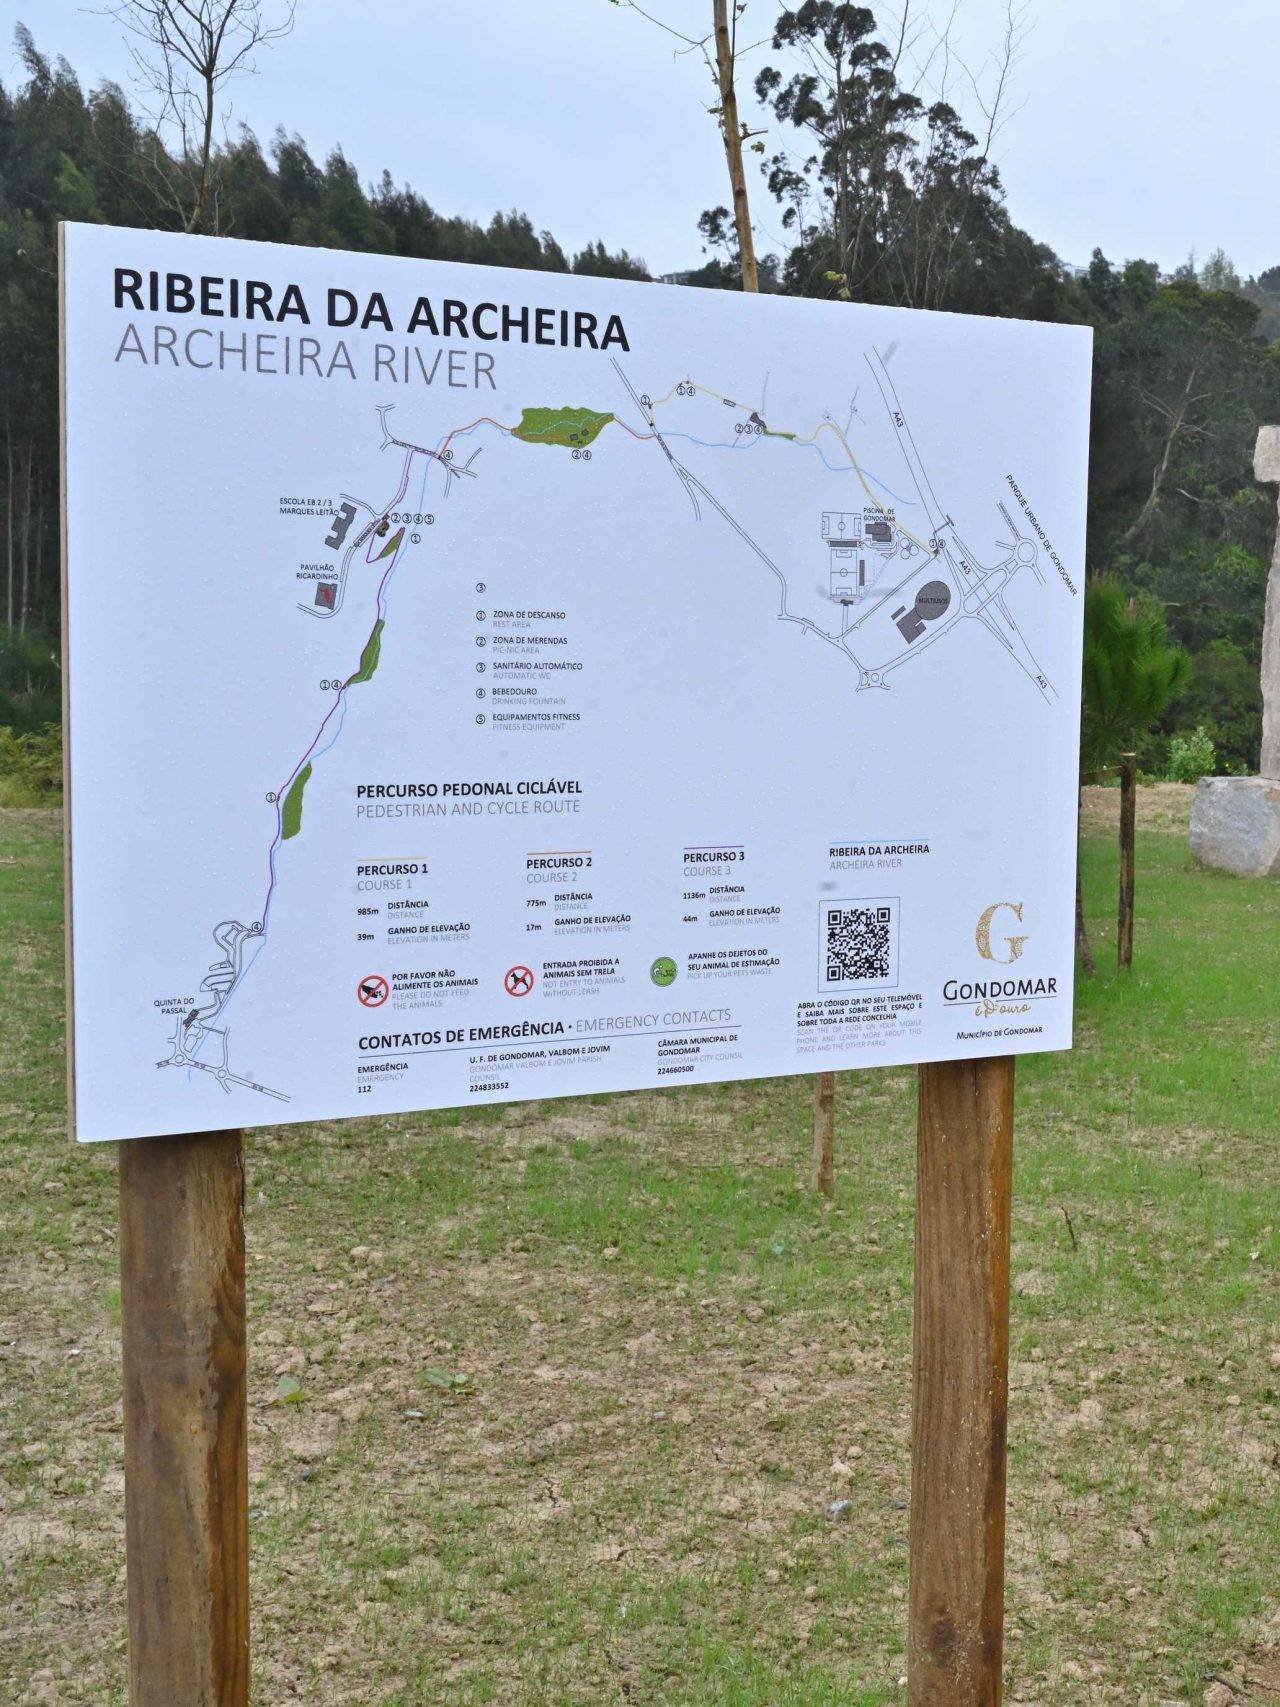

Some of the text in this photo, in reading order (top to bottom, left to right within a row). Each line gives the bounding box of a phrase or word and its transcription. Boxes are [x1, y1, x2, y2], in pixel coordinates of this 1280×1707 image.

[114, 268, 630, 352] RIBEIRA DA ARCHEIRA
[115, 323, 497, 390] ARCHEIRA RIVER
[893, 411, 904, 428] A43
[280, 498, 306, 506] ESCOLA
[307, 498, 316, 506] EB
[279, 507, 340, 516] MARQUES LEITÃO
[1006, 474, 1078, 597] PARQUE URBANO DE GONDOMAR
[300, 563, 335, 572] PAVILHÃO
[959, 560, 971, 575] A43
[296, 572, 339, 581] RICARDINHO
[493, 610, 566, 620] ZONA DE DESCANSO
[493, 636, 514, 644] ZONA
[527, 637, 568, 645] MERENDAS
[493, 661, 583, 671] SANITÁRIO AUTOMÁTICO
[1036, 675, 1048, 690] A43
[492, 688, 538, 696] BEBEDOURO
[492, 713, 551, 722] EQUIPAMENTOS
[357, 778, 583, 798] PERCURSO PEDONAL CICLÁVEL
[357, 800, 581, 818] PEDESTRIAN AND CYCLE ROUTE
[683, 851, 745, 863] PERCURSO 3
[829, 844, 930, 858] RIBEIRA DA ARCHEIRA
[357, 863, 428, 876] PERCURSO 1
[526, 857, 592, 870] PERCURSO 2
[829, 858, 902, 870] ARCHEIRA RIVER
[683, 866, 722, 877] COURSE
[526, 872, 569, 884] COURSE
[357, 879, 402, 892] COURSE
[709, 885, 745, 894] DISTÂNCIA
[554, 892, 593, 901] DISTÂNCIA
[682, 892, 706, 900] 1136m
[388, 900, 430, 910] DISTÂNCIA
[357, 908, 379, 916] 985m
[709, 909, 735, 918] GANHO
[746, 906, 781, 916] ELEVAÇÃO
[554, 918, 582, 926] GANHO
[594, 914, 631, 924] ELEVAÇÃO
[388, 926, 418, 935] GANHO
[431, 922, 471, 932] ELEVAÇÃO
[526, 924, 542, 932] 17m
[975, 901, 1030, 965] G
[357, 932, 375, 941] 39m
[688, 952, 716, 960] APANHE
[728, 949, 757, 958] DEJETOS
[758, 948, 768, 956] DO
[543, 960, 577, 970] ENTRADA
[578, 958, 613, 968] PROIBIDA
[688, 958, 780, 971] SEU ANIMAL DE ESTIMAÇÃO
[392, 968, 456, 982] POR FAVOR NÃO
[543, 968, 616, 980] ANIMAIS SEM TRELA
[392, 982, 432, 991] ALIMENTE
[445, 978, 478, 988] ANIMAIS
[154, 997, 195, 1008] QUINTA DO
[798, 1000, 816, 1010] ABRA
[824, 998, 850, 1008] CÓDIGO
[850, 998, 860, 1006] QR
[862, 997, 872, 1005] NO
[873, 996, 886, 1004] SEU
[887, 993, 923, 1002] TELEMÓVEL
[161, 1006, 188, 1016] PASSAL
[805, 1010, 824, 1018] SAIBA
[828, 1008, 845, 1016] MAIS
[891, 1003, 914, 1012] ESPAÇO
[796, 1019, 818, 1027] SOBRE
[862, 1012, 897, 1022] CONCELHIA
[358, 1008, 732, 1050] CONTATOS DE EMERGÊNCIA EMERGENCY CONTACTS
[658, 1034, 739, 1048] CÂMARA MUNICIPAL DE
[469, 1056, 478, 1064] U.
[488, 1054, 498, 1062] DE
[500, 1050, 547, 1061] GONDOMAR,
[548, 1048, 580, 1057] VALBOM
[587, 1045, 611, 1054] JOVIM
[658, 1046, 701, 1056] GONDOMAR
[358, 1062, 408, 1074] EMERGÊNCIA
[658, 1066, 694, 1075] 224660500
[358, 1085, 372, 1094] 112
[469, 1082, 510, 1092] 224833552
